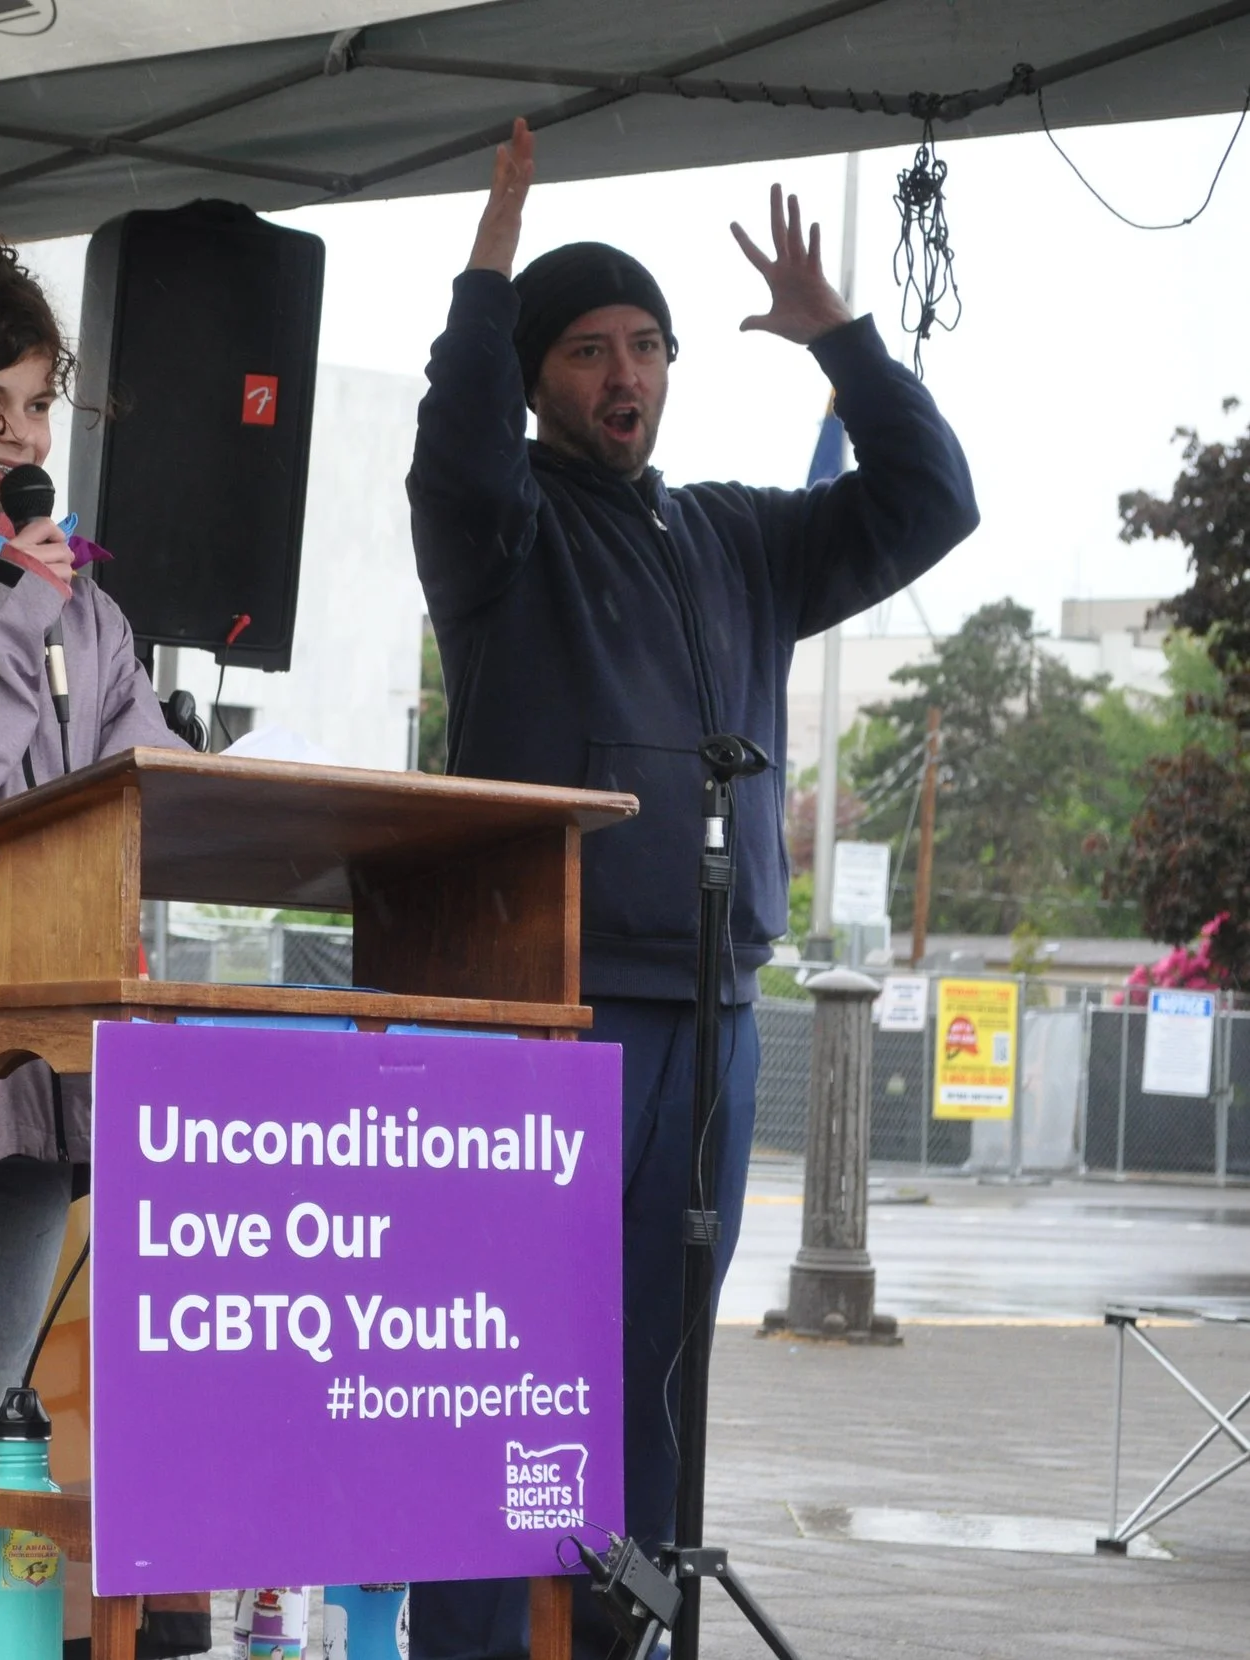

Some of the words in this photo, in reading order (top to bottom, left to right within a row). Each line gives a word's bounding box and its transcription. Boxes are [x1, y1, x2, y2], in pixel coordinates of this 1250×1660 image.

[138, 1104, 585, 1186] Unconditionally
[138, 1199, 272, 1258] Love
[285, 1201, 391, 1259] Our
[138, 1294, 333, 1363] LGBTQ
[344, 1291, 520, 1350] Youth.
[326, 1372, 590, 1429] #bornperfect
[506, 1463, 561, 1485] BASIC
[506, 1485, 573, 1507] RIGHTS
[506, 1507, 584, 1530] OREGON
